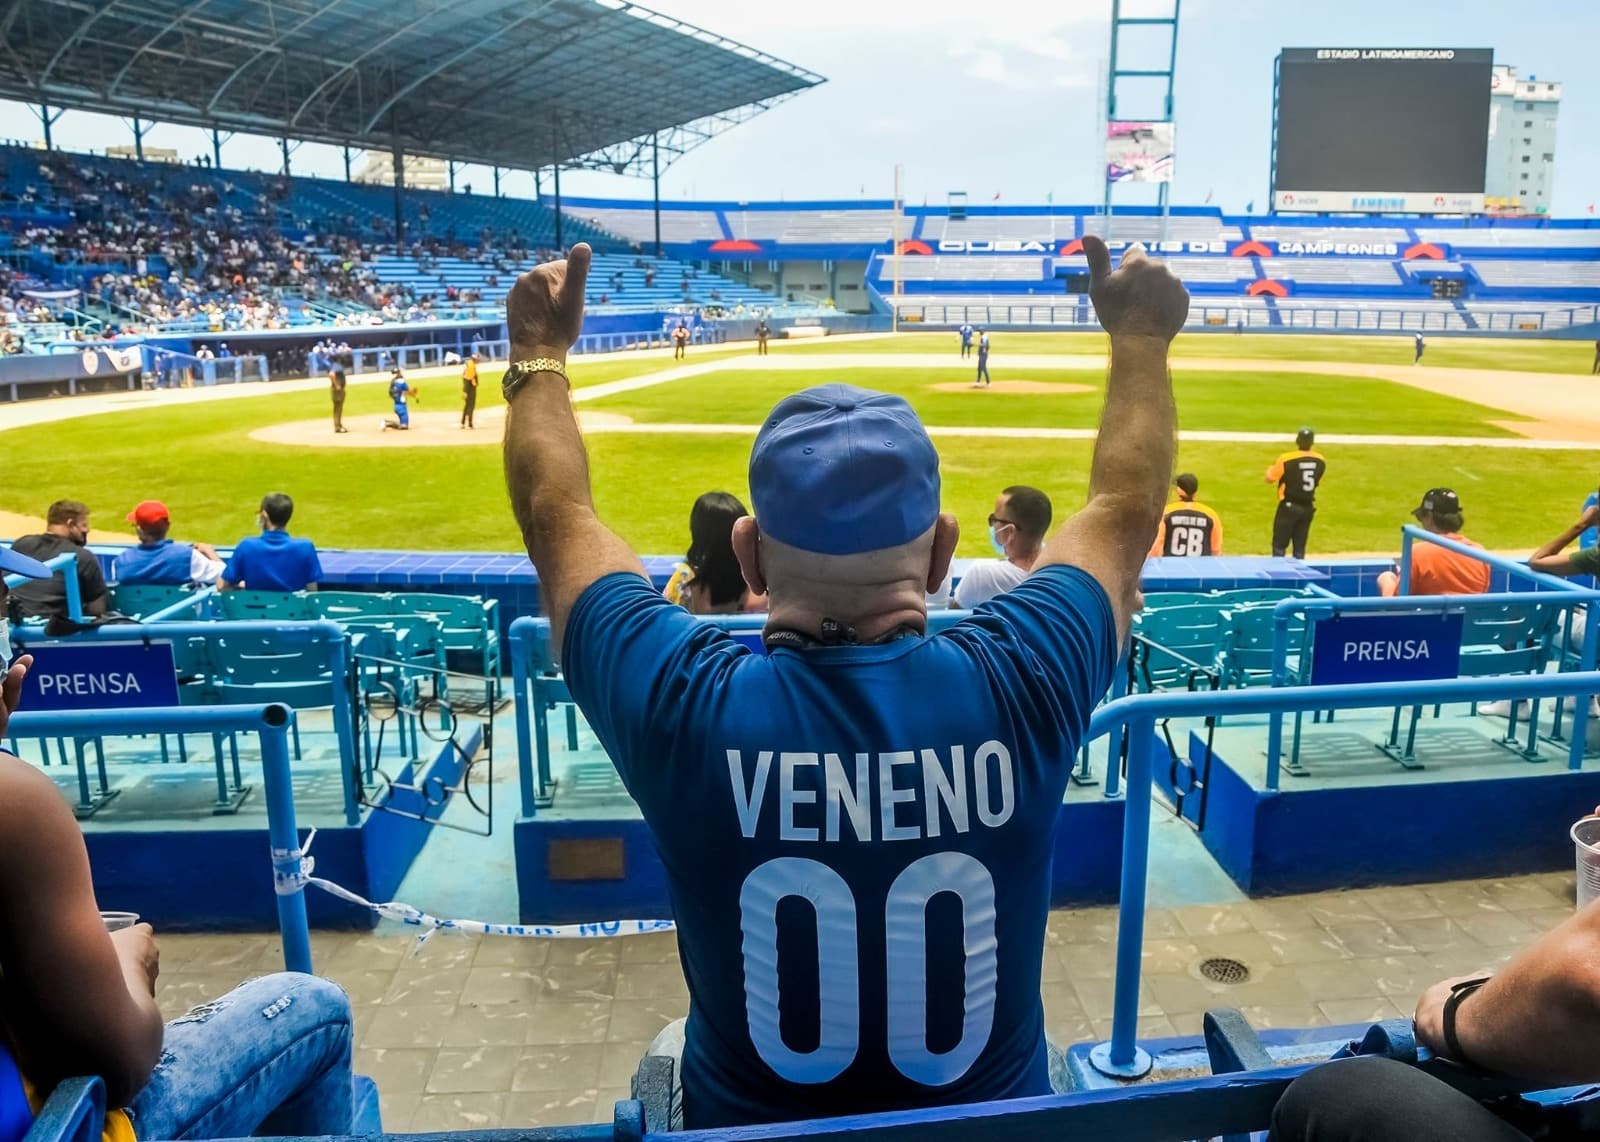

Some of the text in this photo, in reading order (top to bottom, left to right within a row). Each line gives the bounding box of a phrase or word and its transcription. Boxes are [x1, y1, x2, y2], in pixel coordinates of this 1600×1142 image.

[1317, 49, 1455, 60] ESTADIO LATINOAMERICANO
[1189, 241, 1227, 253] DE
[1278, 242, 1398, 255] CAMPEONES
[1302, 470, 1315, 492] 5
[1171, 527, 1204, 556] CB
[1343, 639, 1430, 662] PRENSA
[38, 672, 142, 696] PRENSA
[726, 739, 1015, 842] VENENO
[739, 851, 998, 1086] 00
